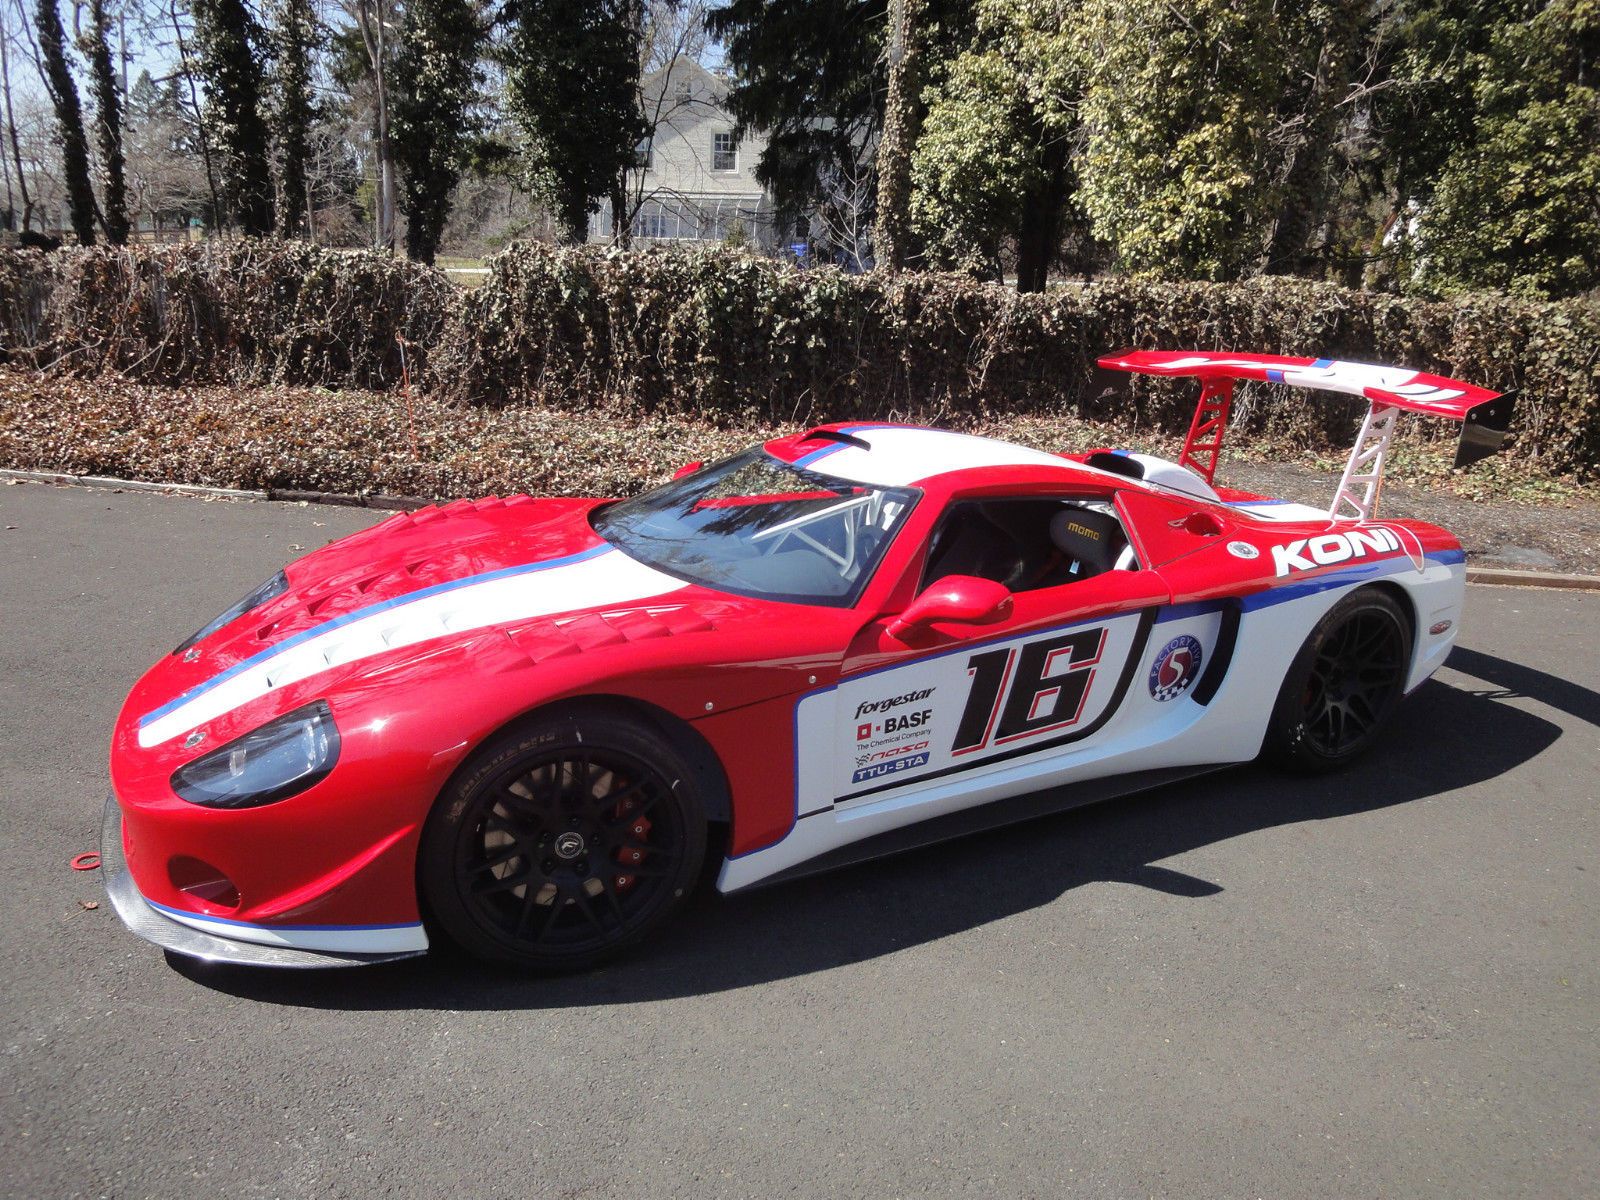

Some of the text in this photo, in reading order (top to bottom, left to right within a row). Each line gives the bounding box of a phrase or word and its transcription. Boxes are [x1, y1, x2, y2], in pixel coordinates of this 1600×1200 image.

[1067, 522, 1100, 540] momo
[1272, 528, 1400, 578] KONI
[1151, 636, 1192, 677] FACTORY
[854, 686, 937, 720] forgestar
[951, 627, 1109, 757] 16
[884, 709, 933, 734] BASF
[857, 728, 932, 751] The Chemical Company
[857, 756, 925, 779] TTU-STA
